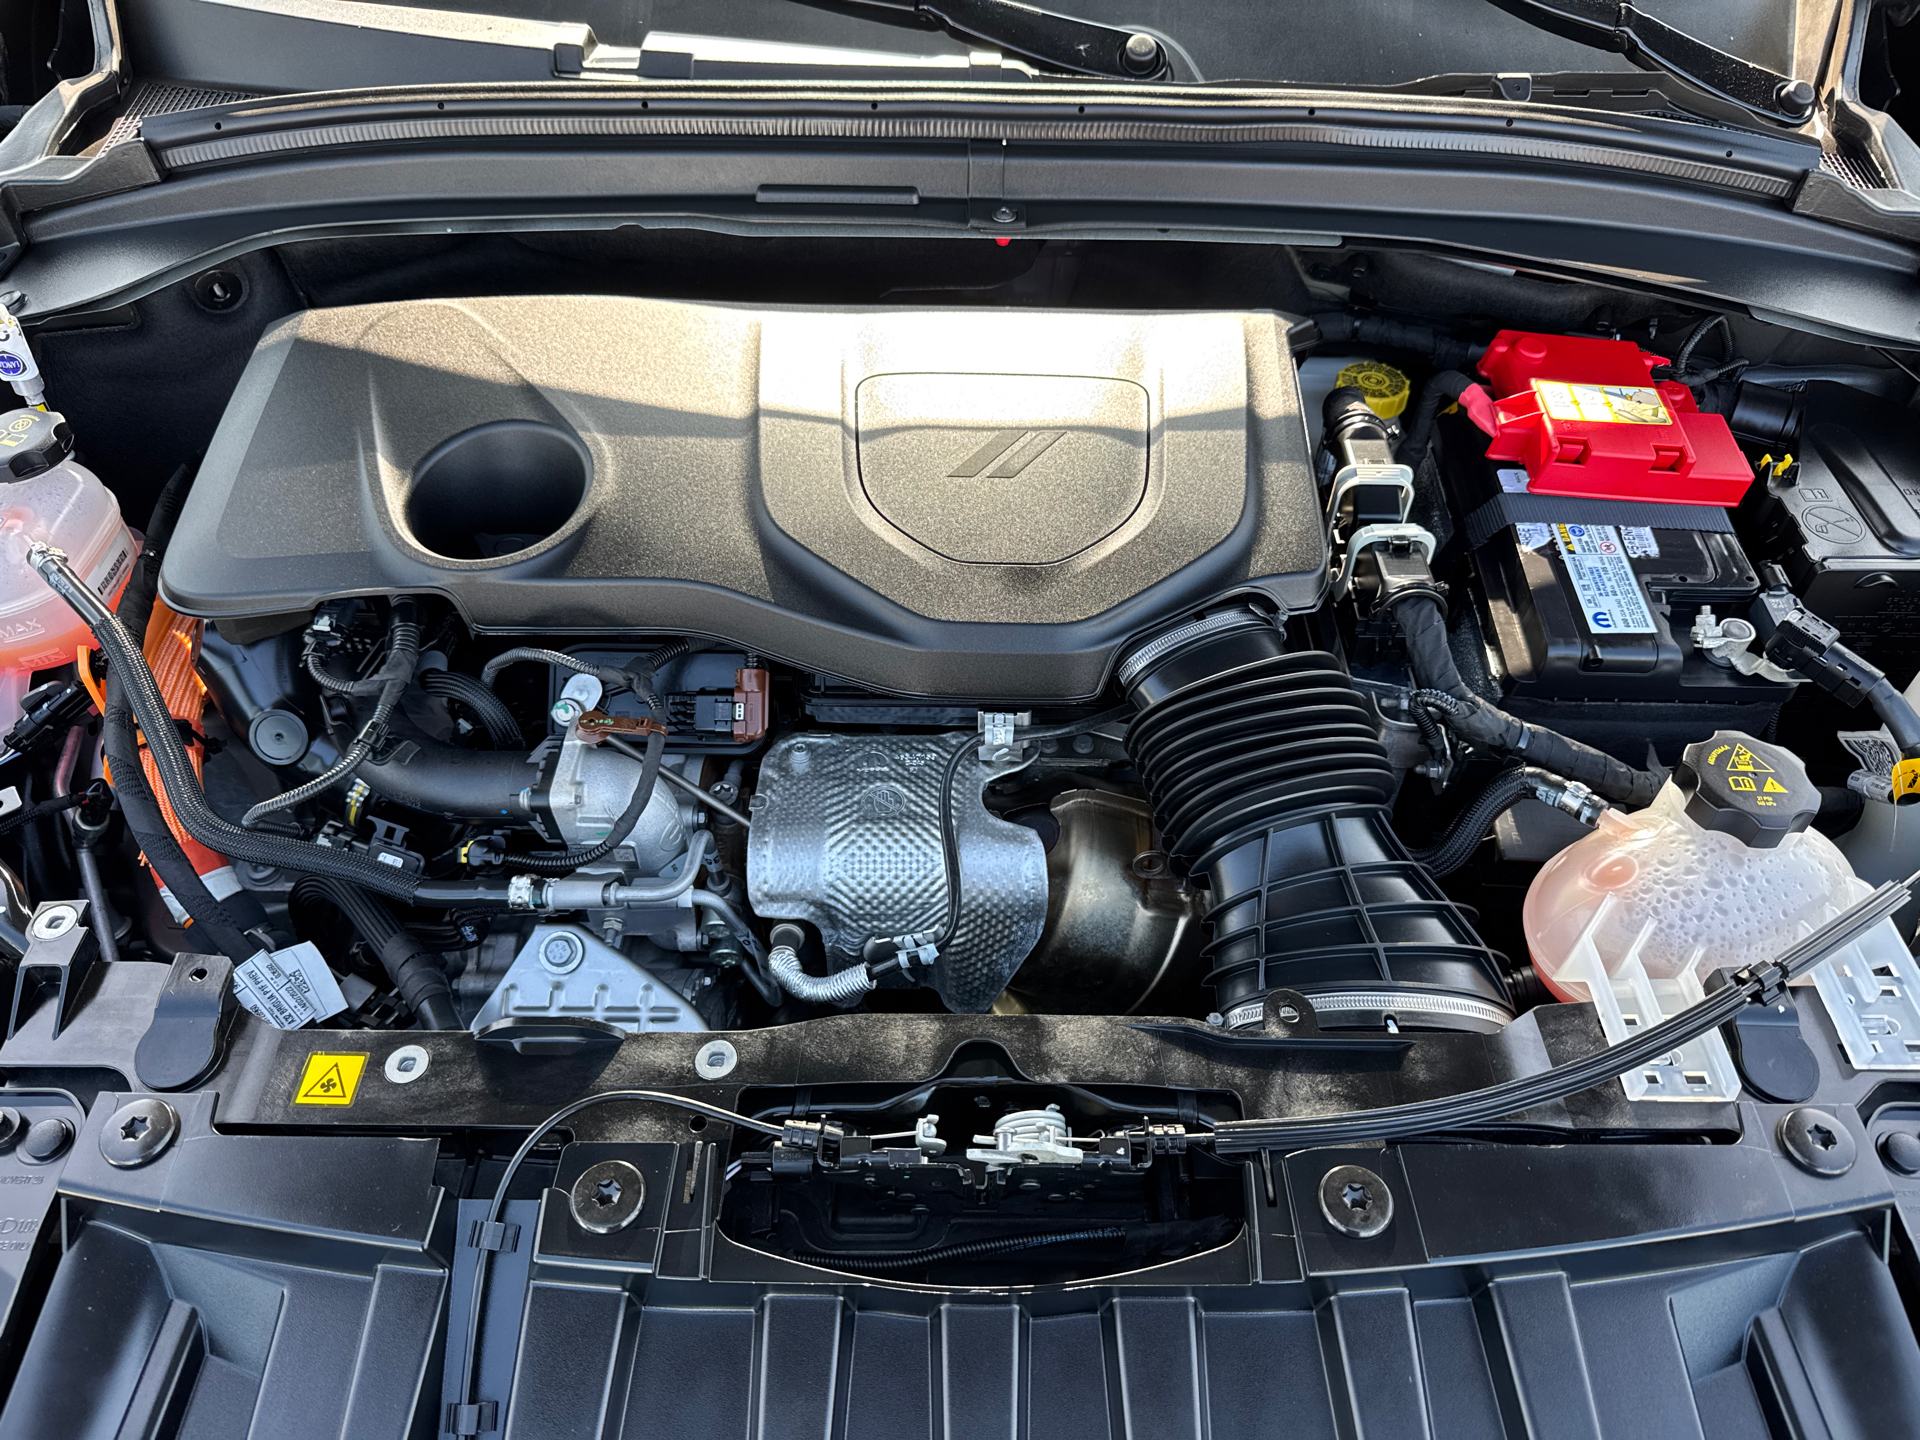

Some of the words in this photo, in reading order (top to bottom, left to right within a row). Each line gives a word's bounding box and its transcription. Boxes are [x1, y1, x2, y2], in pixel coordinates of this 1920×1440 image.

[1593, 566, 1610, 596] REPLACEMENT
[0, 618, 42, 638] MAX
[246, 969, 261, 986] PHEV
[266, 992, 288, 1016] BRIGLIA
[282, 1012, 297, 1025] A32
